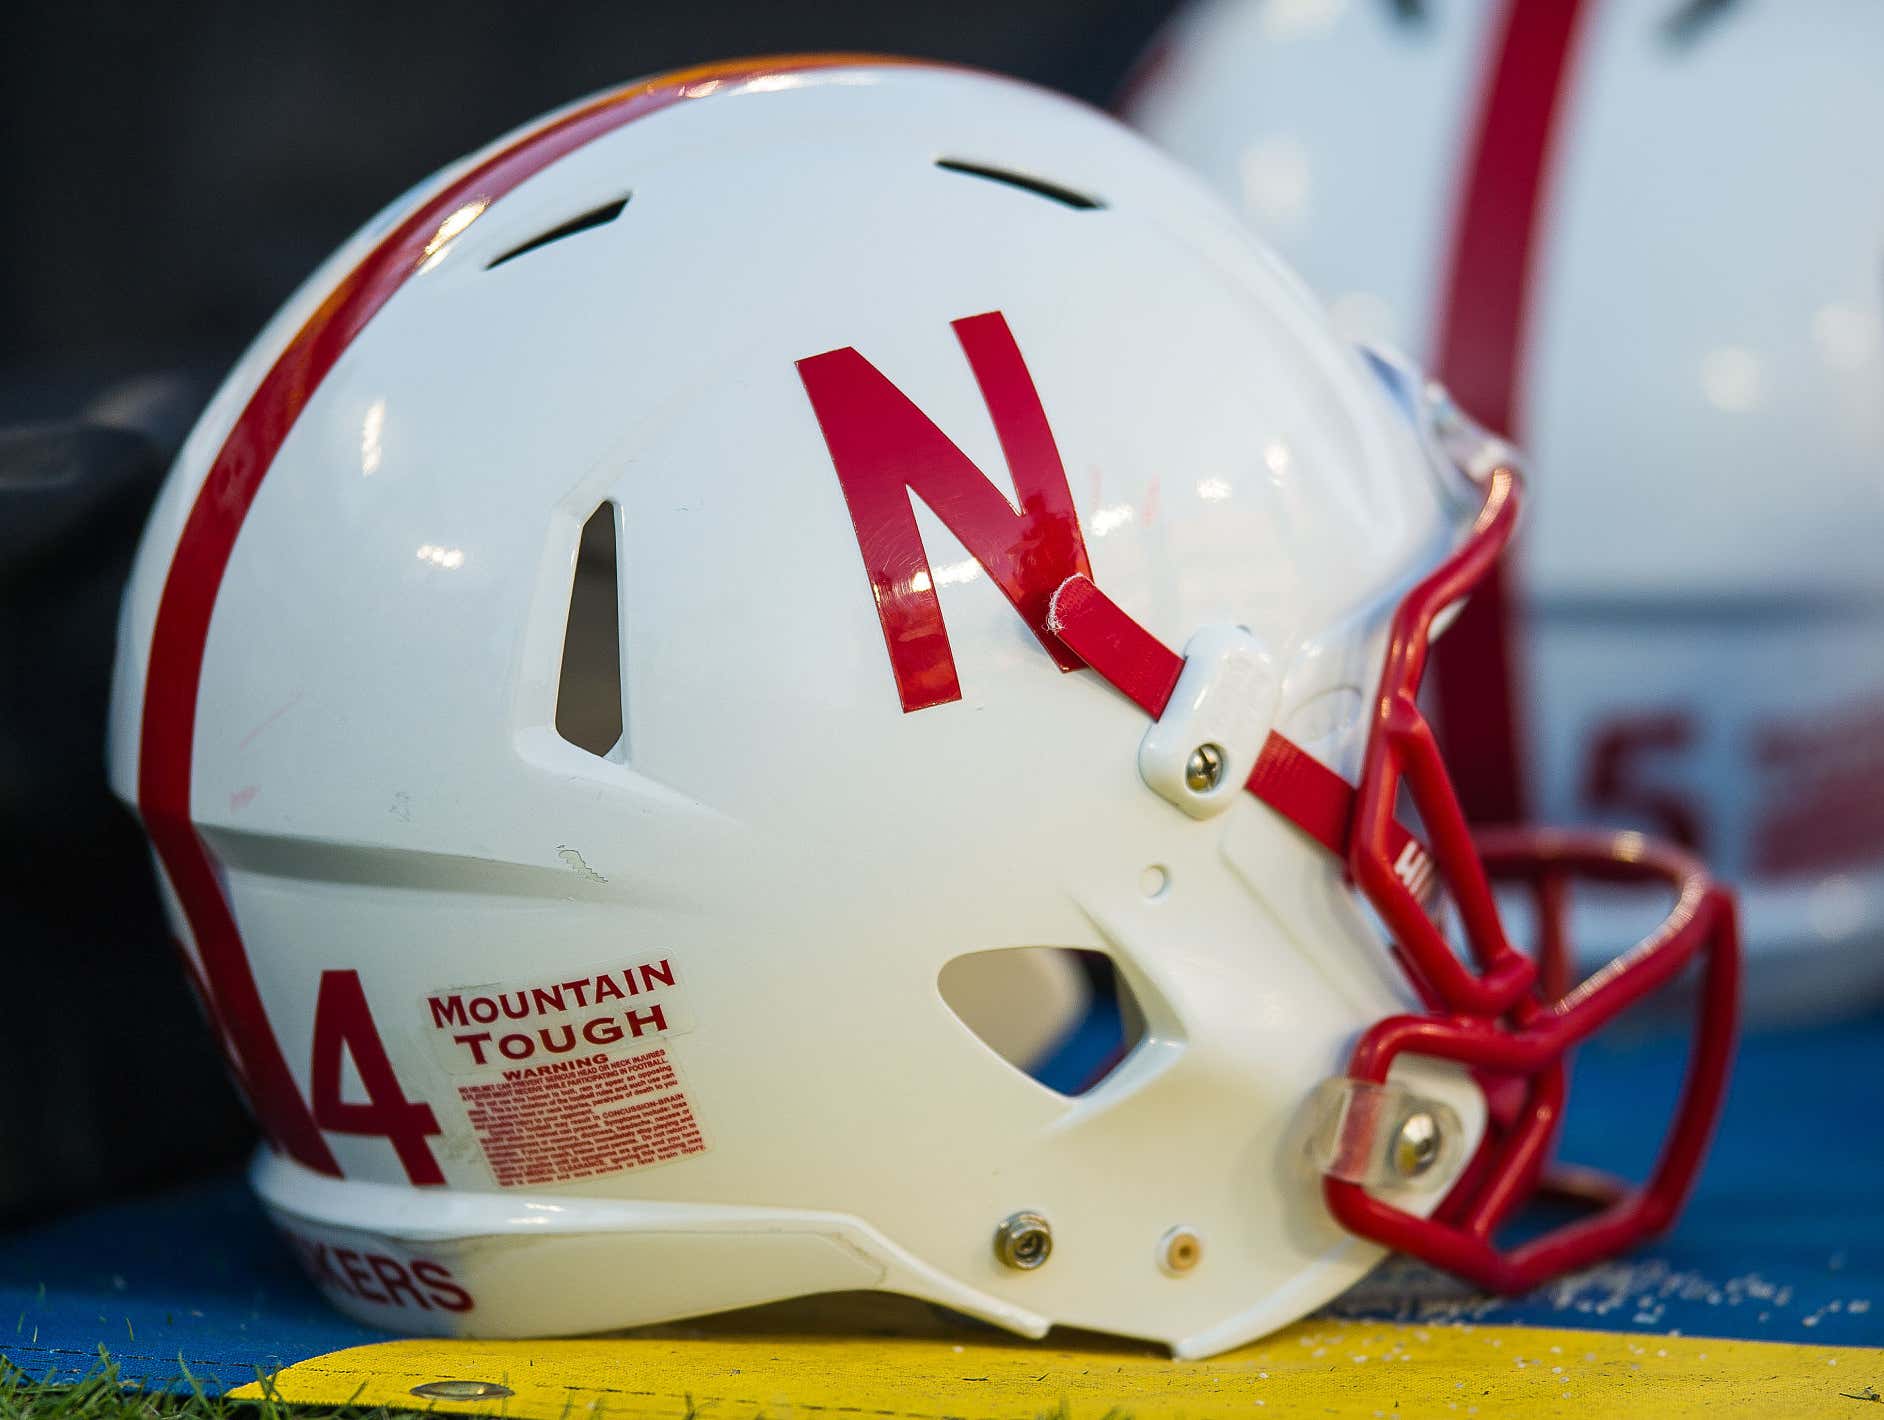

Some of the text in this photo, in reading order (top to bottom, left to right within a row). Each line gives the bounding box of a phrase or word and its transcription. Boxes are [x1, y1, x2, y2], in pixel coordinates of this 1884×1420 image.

[794, 311, 1094, 713] N
[427, 959, 676, 1029] MOUNTAIN
[453, 1004, 668, 1065] TOUGH
[502, 1053, 609, 1081] WARNING
[311, 969, 447, 1187] 4
[577, 1067, 597, 1076] HEAD
[611, 1059, 630, 1069] NECK
